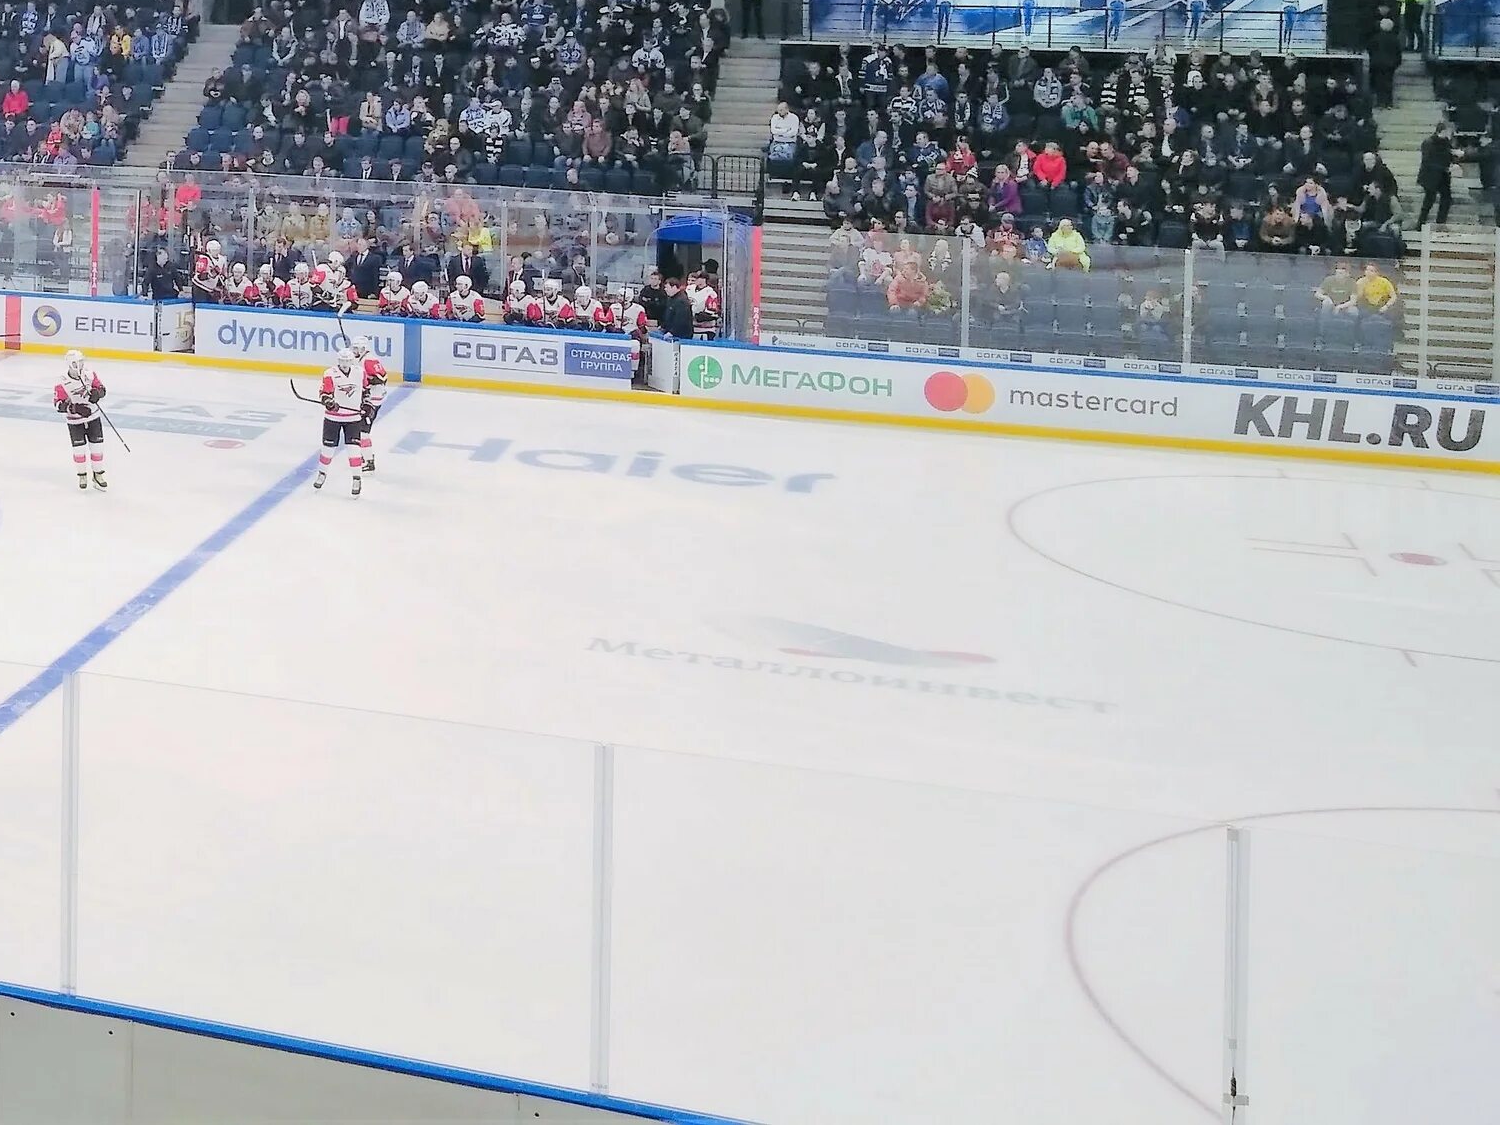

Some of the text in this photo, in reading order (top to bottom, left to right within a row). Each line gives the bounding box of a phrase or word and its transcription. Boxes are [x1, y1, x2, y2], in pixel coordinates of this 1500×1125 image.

[453, 339, 559, 366] СОГАЗ
[570, 347, 633, 362] СТРАХОВАЯ
[580, 359, 623, 373] ГРУППА
[1009, 386, 1179, 417] mastercard
[1234, 393, 1486, 452] KHL.RU
[388, 430, 838, 495] Haier
[586, 635, 1118, 717] Металлоинвест
